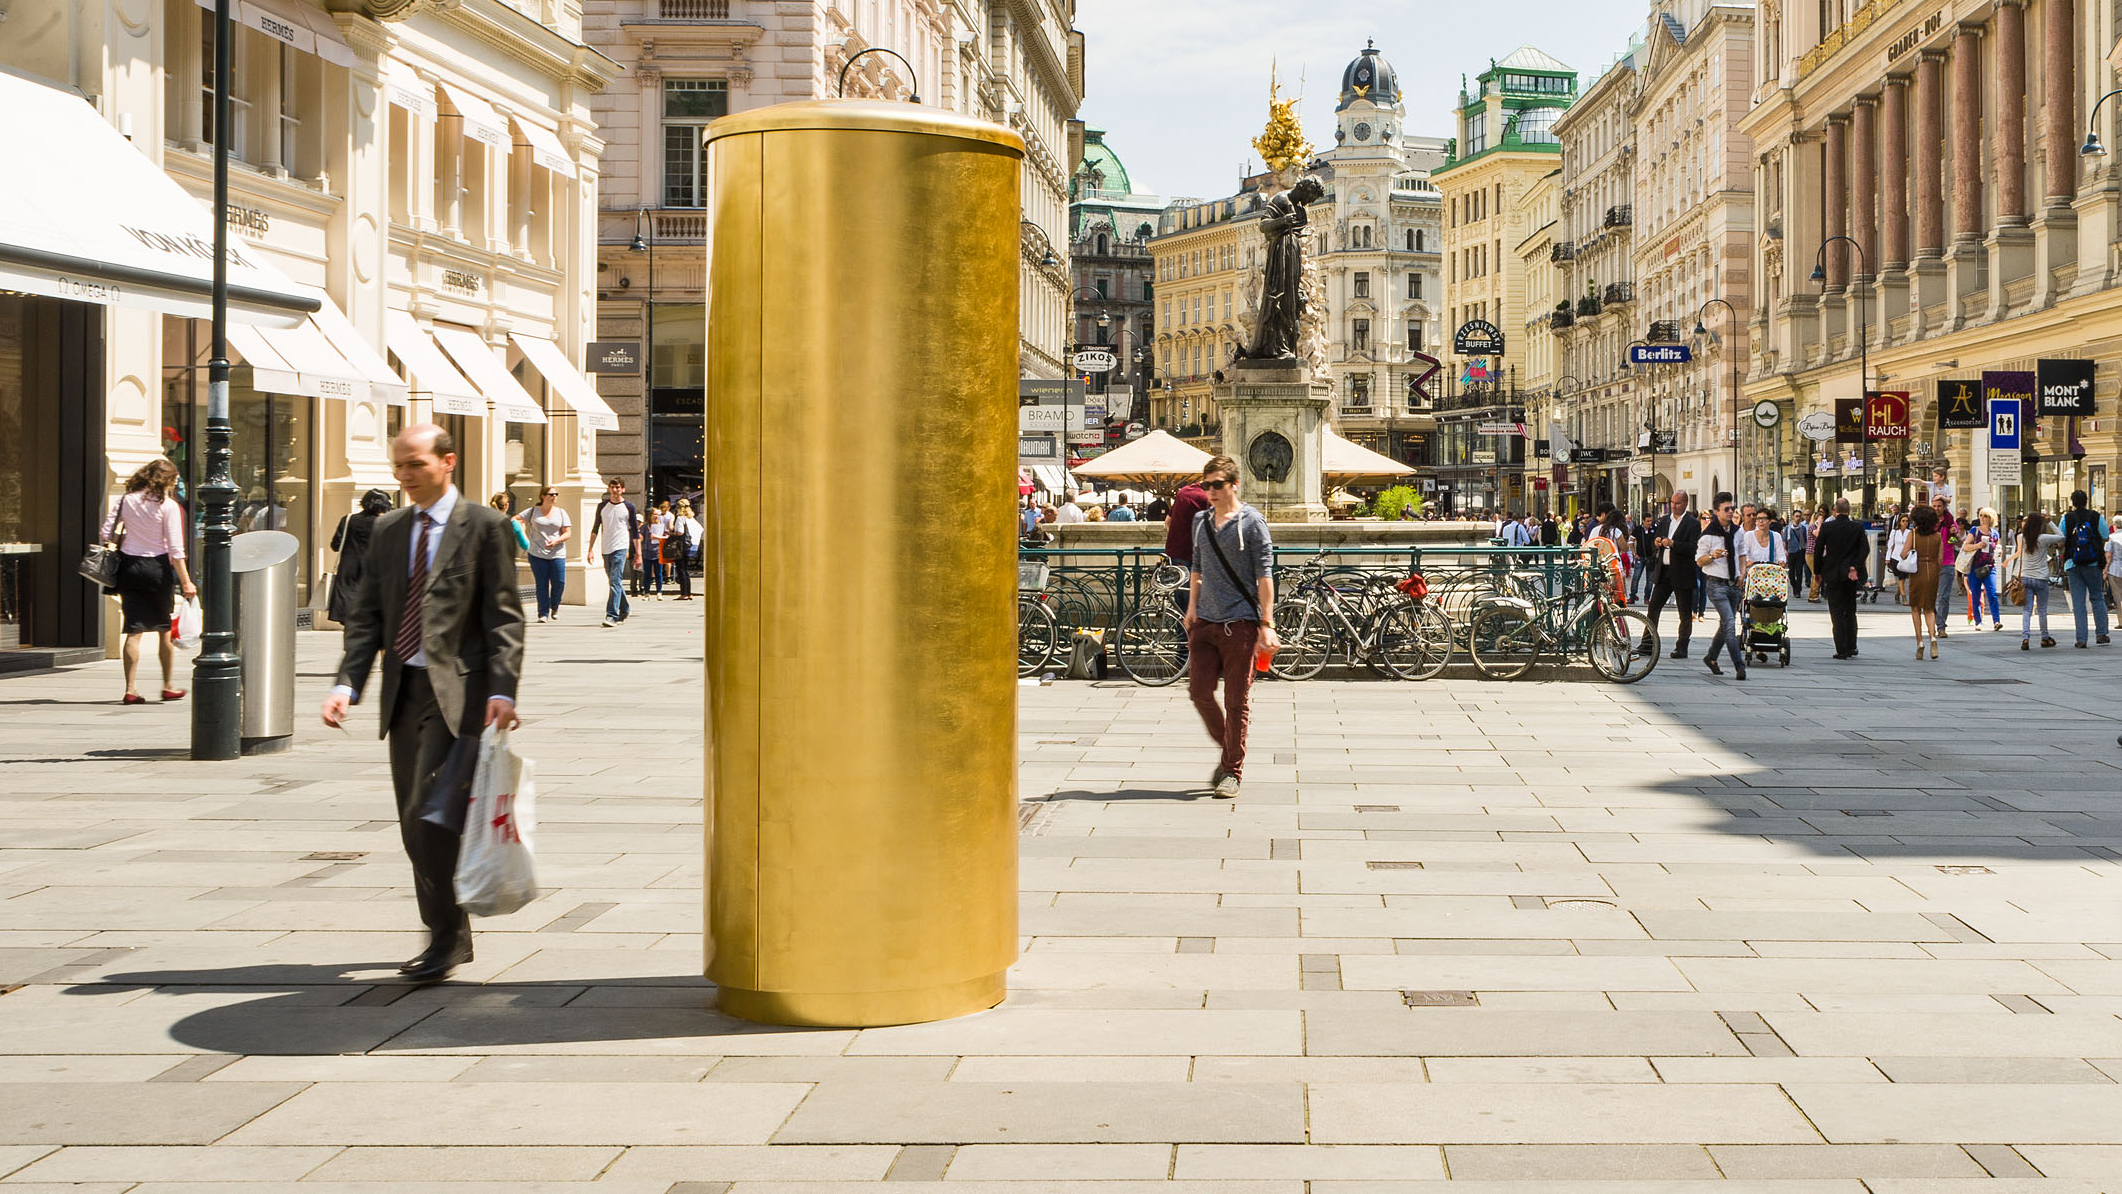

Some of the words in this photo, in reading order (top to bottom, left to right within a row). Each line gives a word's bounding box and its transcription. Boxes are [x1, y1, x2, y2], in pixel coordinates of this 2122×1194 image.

[226, 204, 269, 232] ERMÈS
[119, 223, 180, 255] VON
[72, 281, 107, 298] OMEGA
[1078, 353, 1112, 363] ZIKOS
[1637, 347, 1682, 360] Berlitz
[1986, 387, 2032, 402] Monsoon
[2044, 385, 2080, 396] MONT
[676, 397, 704, 406] ESCAD
[2044, 396, 2080, 407] BLANC
[1028, 410, 1075, 421] BRAMO
[1868, 425, 1907, 436] RAUCH
[1020, 440, 1051, 456] LAUMAX
[1916, 441, 1931, 455] RAUCH
